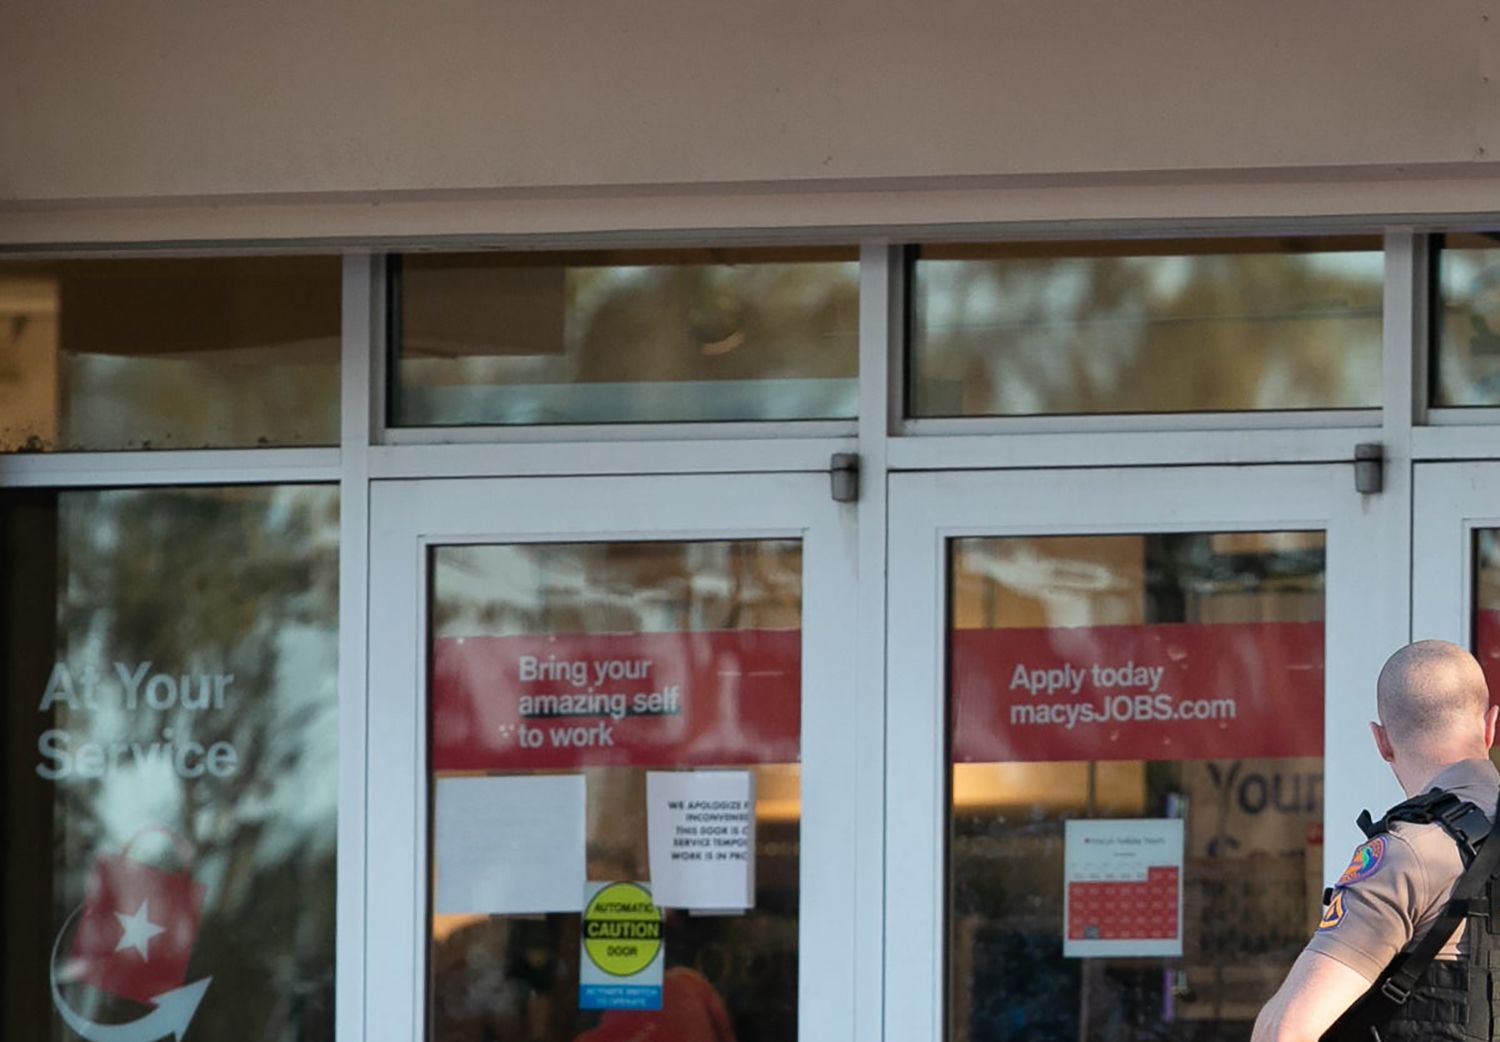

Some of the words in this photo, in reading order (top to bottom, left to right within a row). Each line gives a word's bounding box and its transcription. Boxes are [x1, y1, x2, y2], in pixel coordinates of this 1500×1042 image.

[519, 654, 587, 685] Bring
[593, 659, 651, 684] your
[1010, 662, 1085, 695] Apply
[1091, 661, 1164, 691] today
[39, 662, 101, 711] At
[114, 661, 235, 711] Your
[519, 687, 626, 719] amazing
[633, 686, 680, 712] self
[1010, 694, 1236, 729] macysJOBS.com
[518, 723, 544, 748] to
[550, 721, 613, 746] work
[35, 728, 238, 780] Service
[595, 902, 654, 913] AUTOMATIC
[587, 922, 659, 938] CAUTION
[607, 946, 638, 956] DOOR
